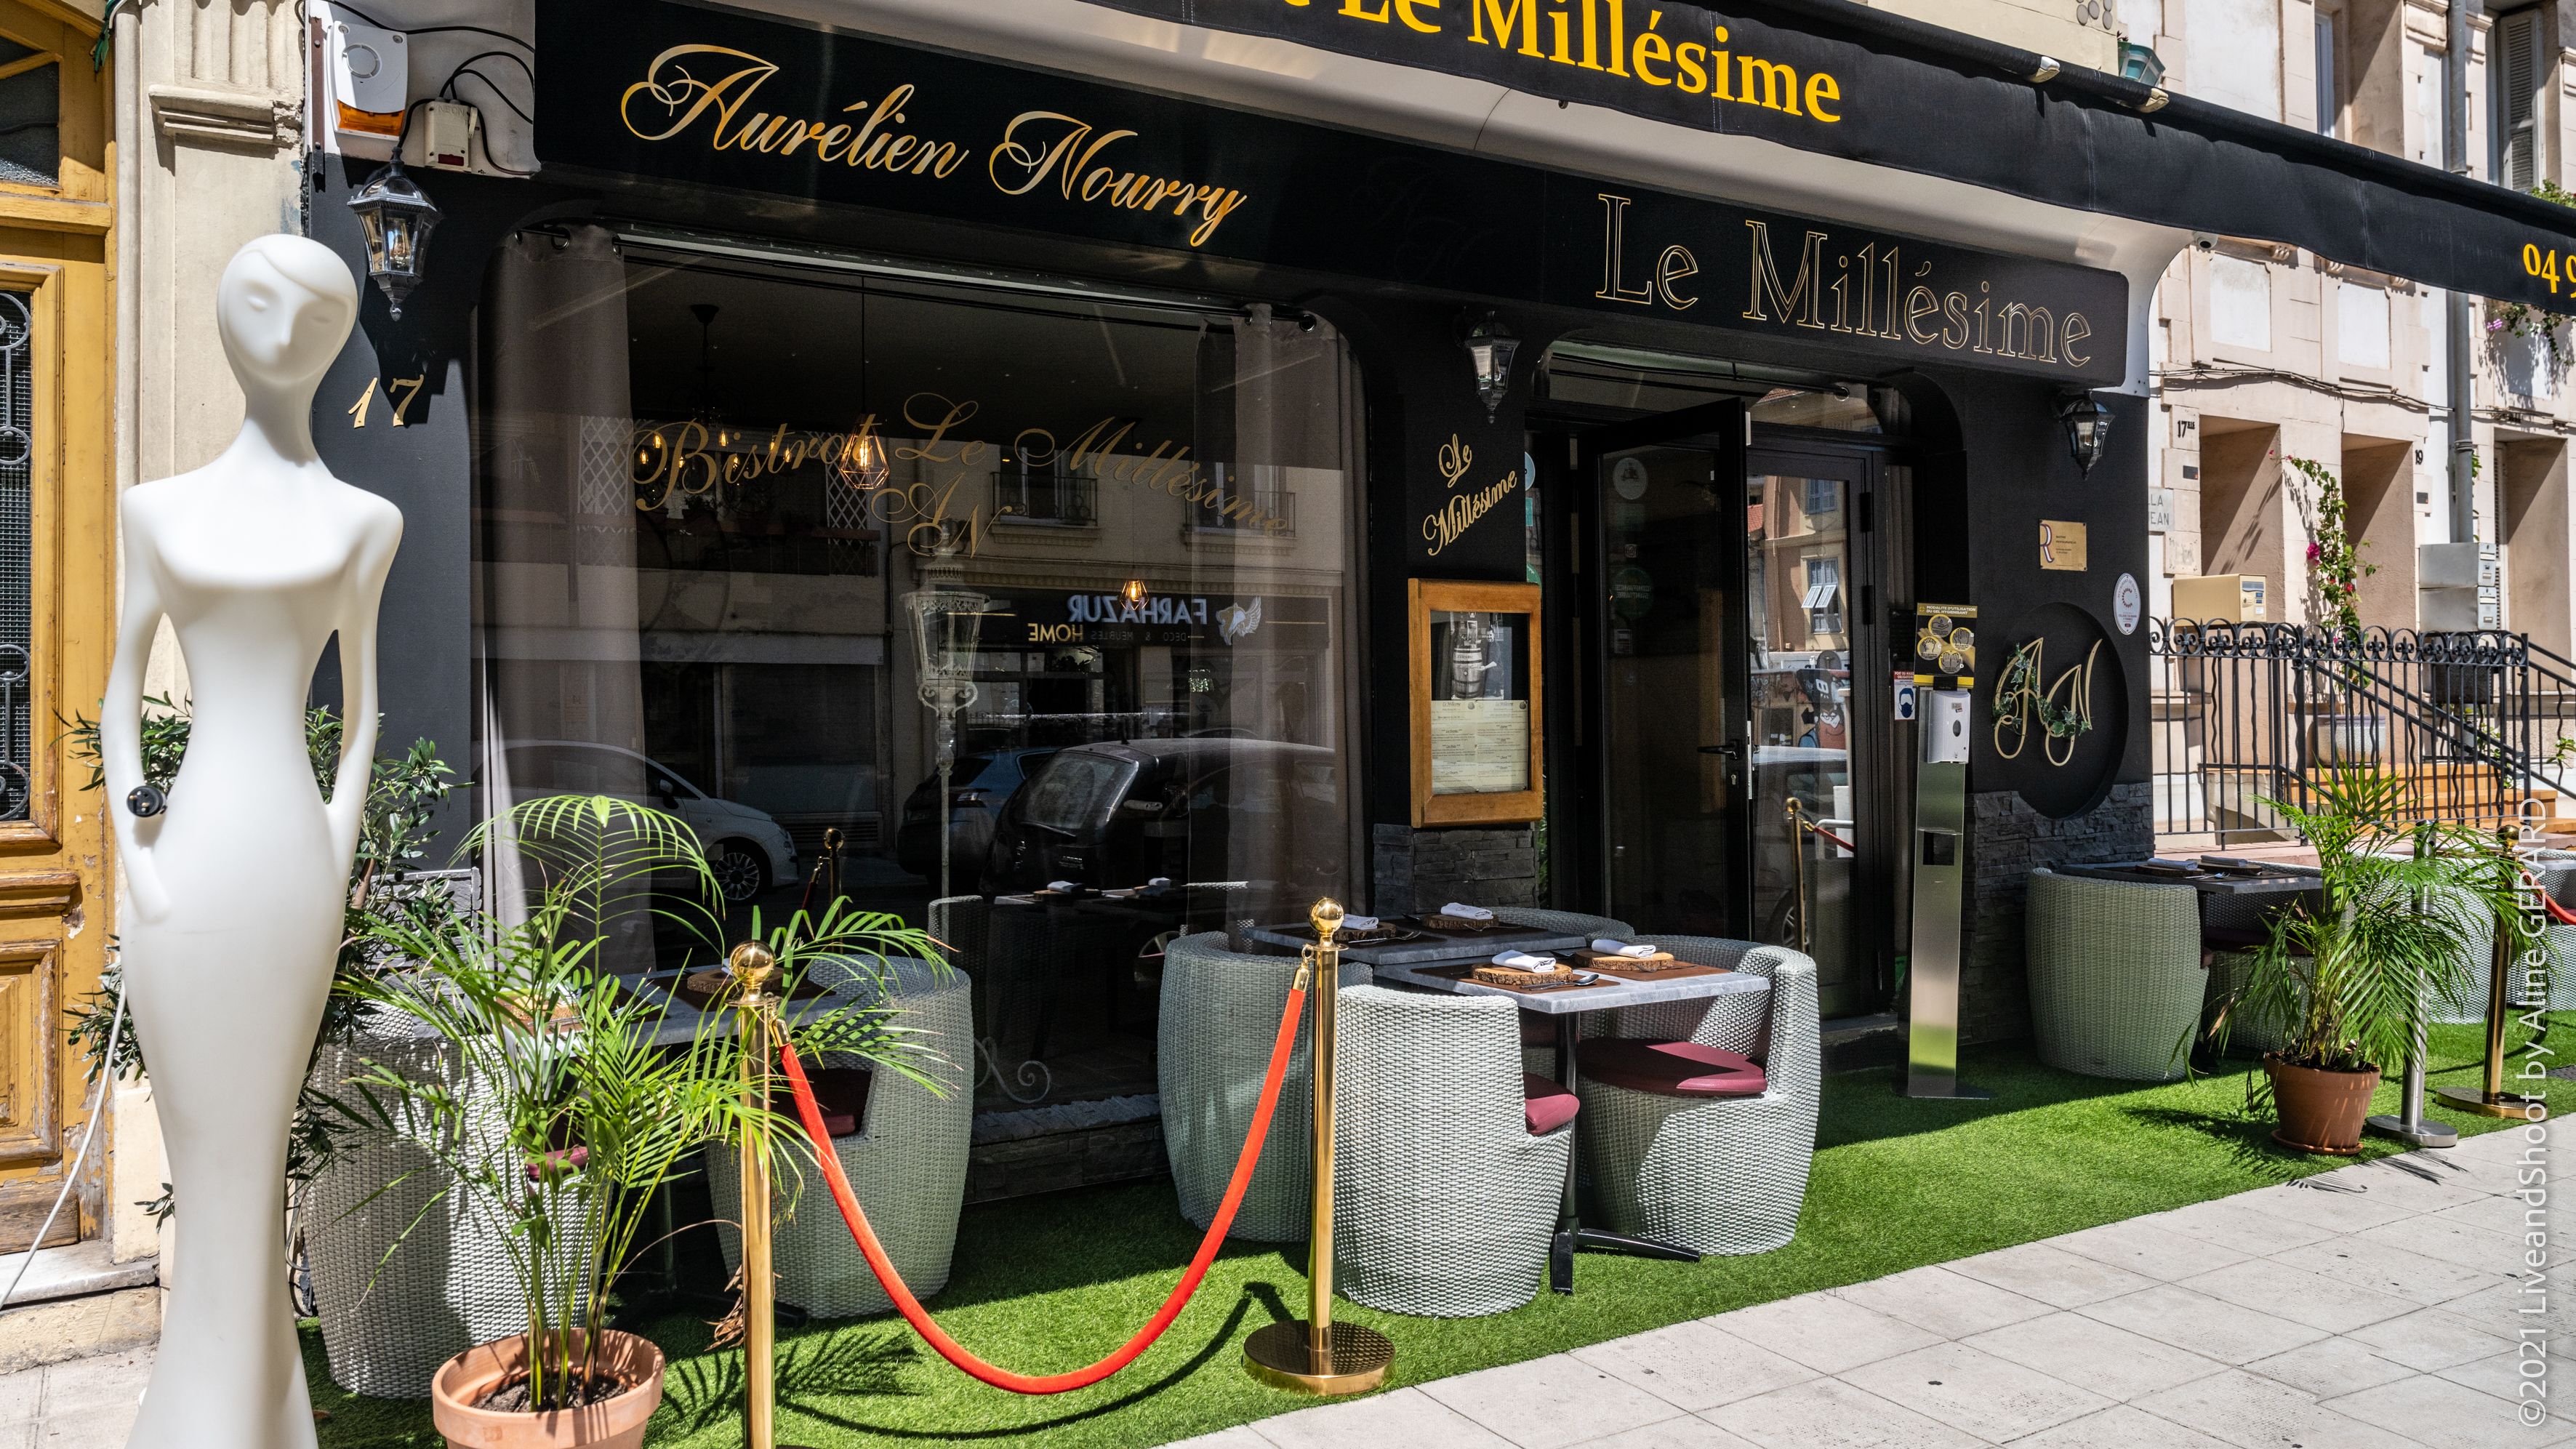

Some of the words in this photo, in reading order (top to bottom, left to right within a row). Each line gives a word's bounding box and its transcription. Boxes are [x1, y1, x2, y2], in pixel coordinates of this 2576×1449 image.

[1467, 0, 1842, 123] Millésime
[621, 44, 969, 179] Aurélien
[990, 111, 1247, 247] Nourry
[1596, 193, 1698, 310] Le
[1743, 220, 2091, 367] Millésime
[348, 374, 425, 429] 17
[630, 413, 882, 512] Bistrot
[894, 392, 988, 467] Le
[1014, 416, 1288, 538] Millésime
[1438, 433, 1472, 488] Le
[2415, 449, 2423, 465] 19
[1423, 470, 1517, 556] Millésime
[2148, 494, 2164, 507] LA
[2148, 511, 2170, 526] EAN
